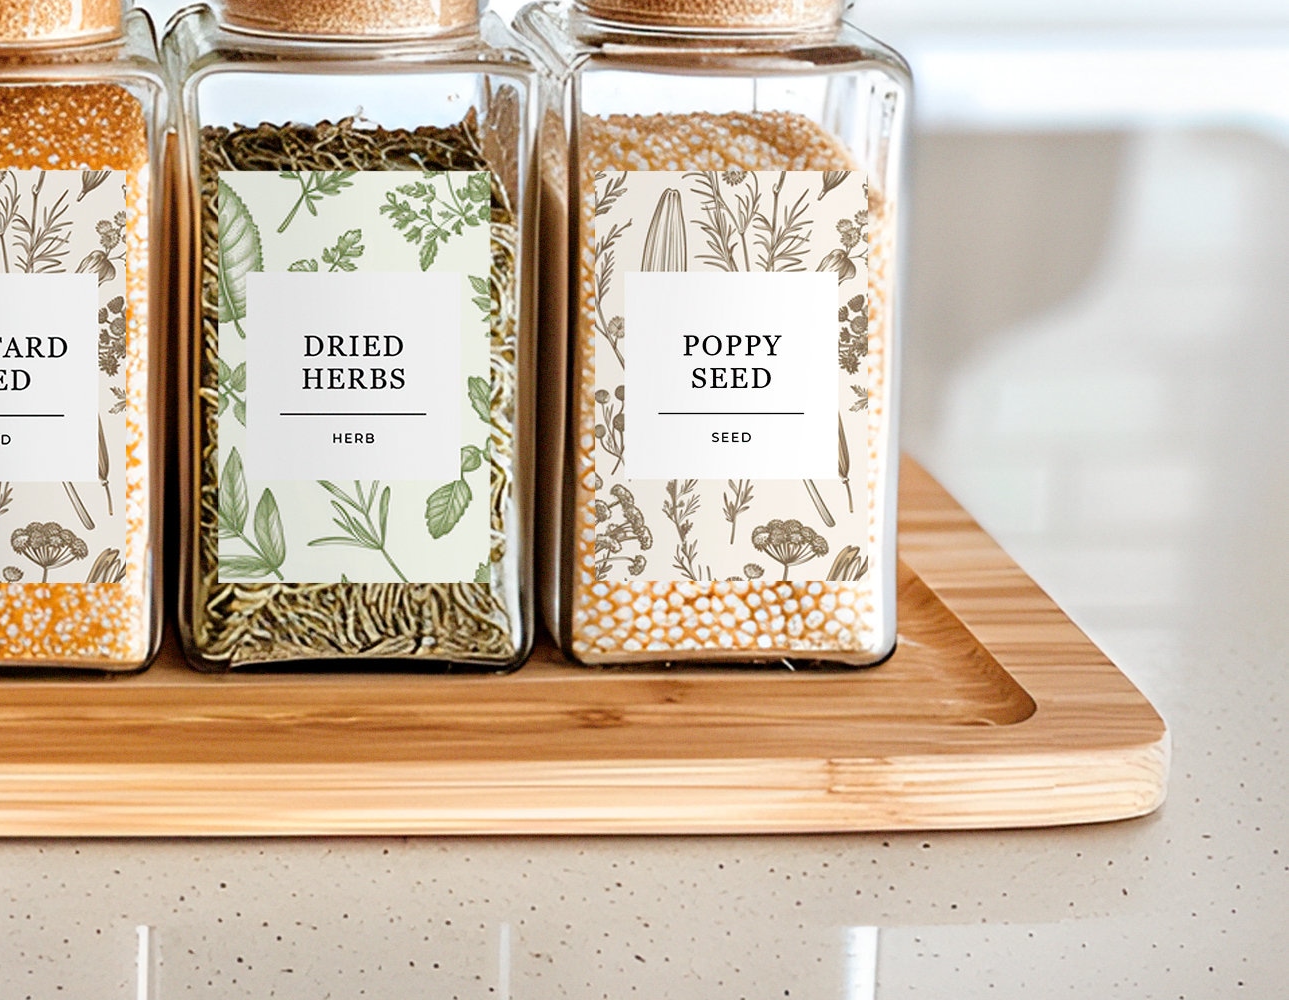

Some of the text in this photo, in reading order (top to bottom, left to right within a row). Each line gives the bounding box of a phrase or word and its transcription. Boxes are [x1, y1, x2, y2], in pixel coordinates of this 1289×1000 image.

[303, 335, 404, 357] DRIED
[683, 334, 783, 357] POPPY
[301, 367, 406, 390] HERBS
[691, 367, 772, 389] SEED
[332, 432, 375, 444] HERB
[711, 431, 752, 443] SEED
